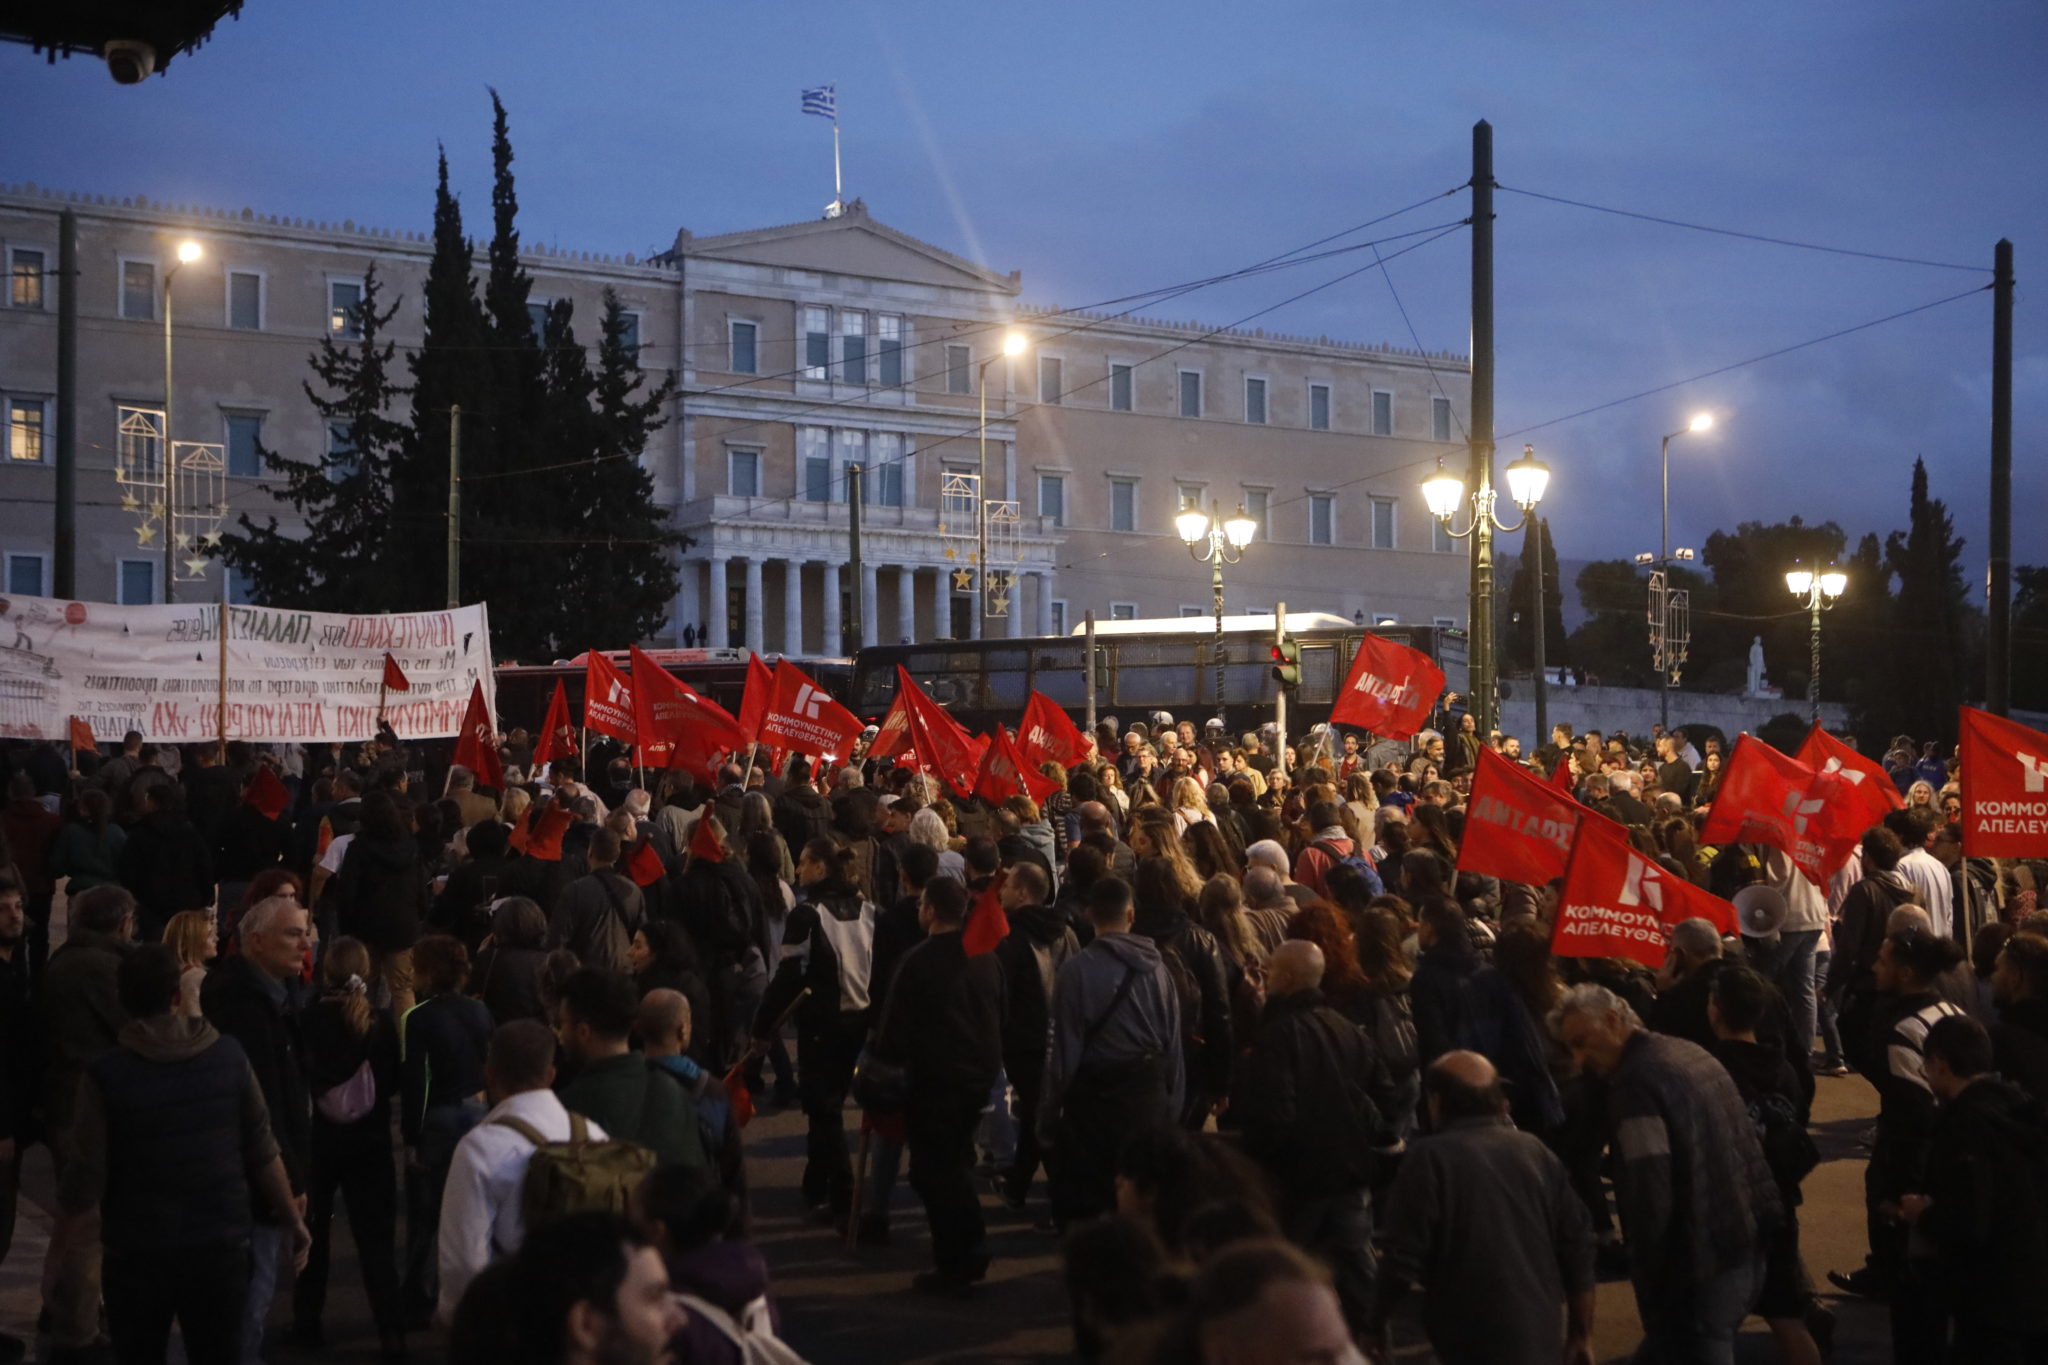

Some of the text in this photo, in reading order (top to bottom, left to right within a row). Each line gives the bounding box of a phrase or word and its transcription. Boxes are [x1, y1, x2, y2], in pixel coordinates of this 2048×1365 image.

[765, 723, 836, 749] ΑΠΕΛΕΥΘΕΡΩΣΗ
[766, 712, 842, 743] ΚΟΜΜΟΥΝΙΣΤΙΚΗ
[1975, 800, 2048, 817] ΚΟΜΜΟ
[1472, 795, 1578, 851] ΑΝΤΑΡΣ
